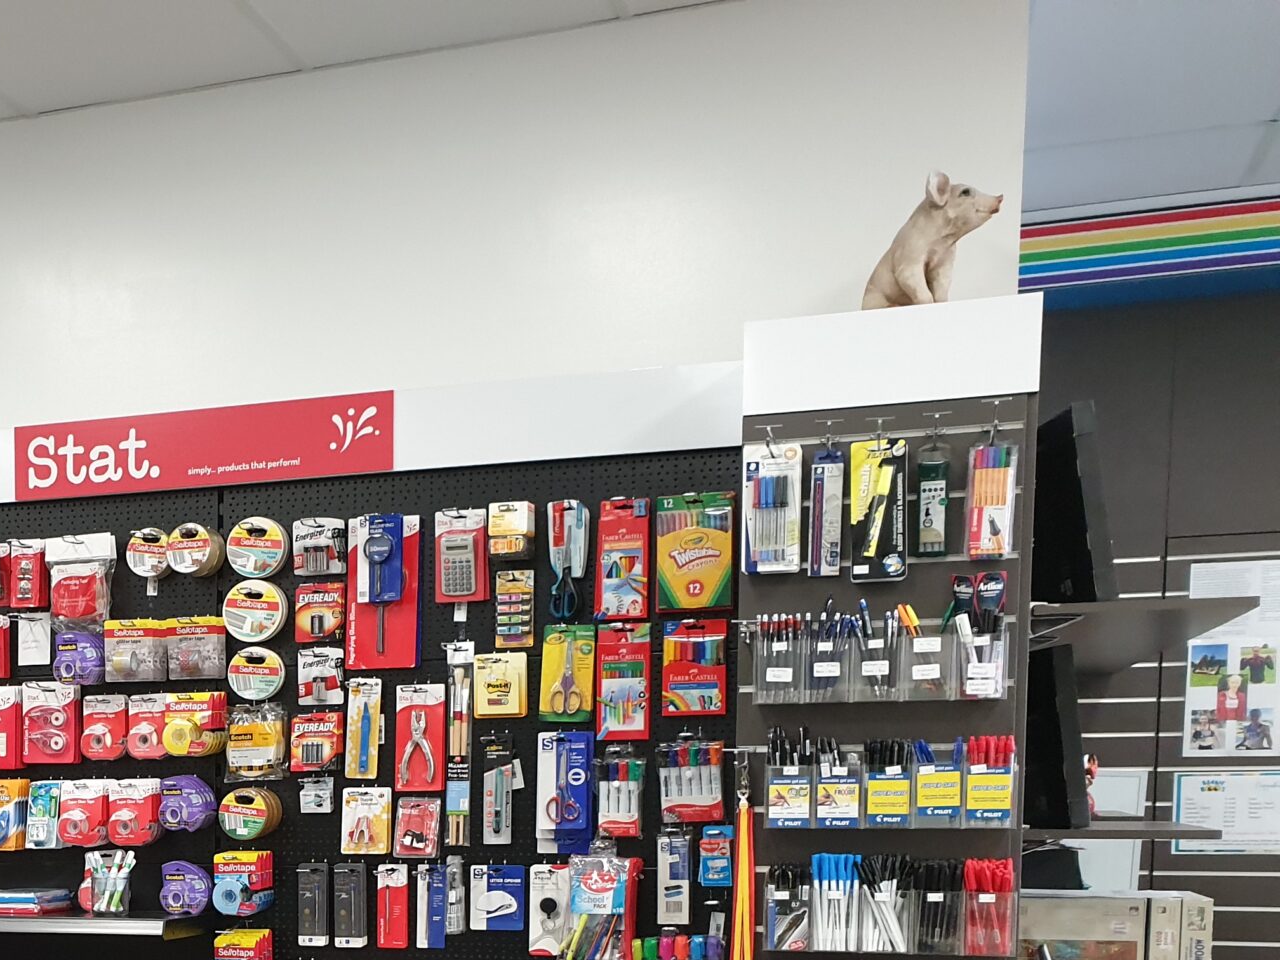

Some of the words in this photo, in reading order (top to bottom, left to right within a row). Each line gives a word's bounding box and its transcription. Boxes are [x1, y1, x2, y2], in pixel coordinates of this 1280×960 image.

[27, 427, 161, 490] Stat.
[218, 462, 250, 475] products
[251, 460, 266, 470] that
[267, 456, 301, 470] perform!
[663, 499, 674, 508] 12
[295, 528, 326, 542] Energizer
[689, 584, 701, 594] 12
[298, 592, 339, 604] EVEREADY
[303, 657, 331, 670] Energizer
[170, 701, 208, 711] Sellotape
[294, 721, 335, 733] EVEREADY
[934, 807, 953, 815] PILOT
[218, 863, 256, 873] Sellotape
[218, 948, 255, 958] Sellotape
